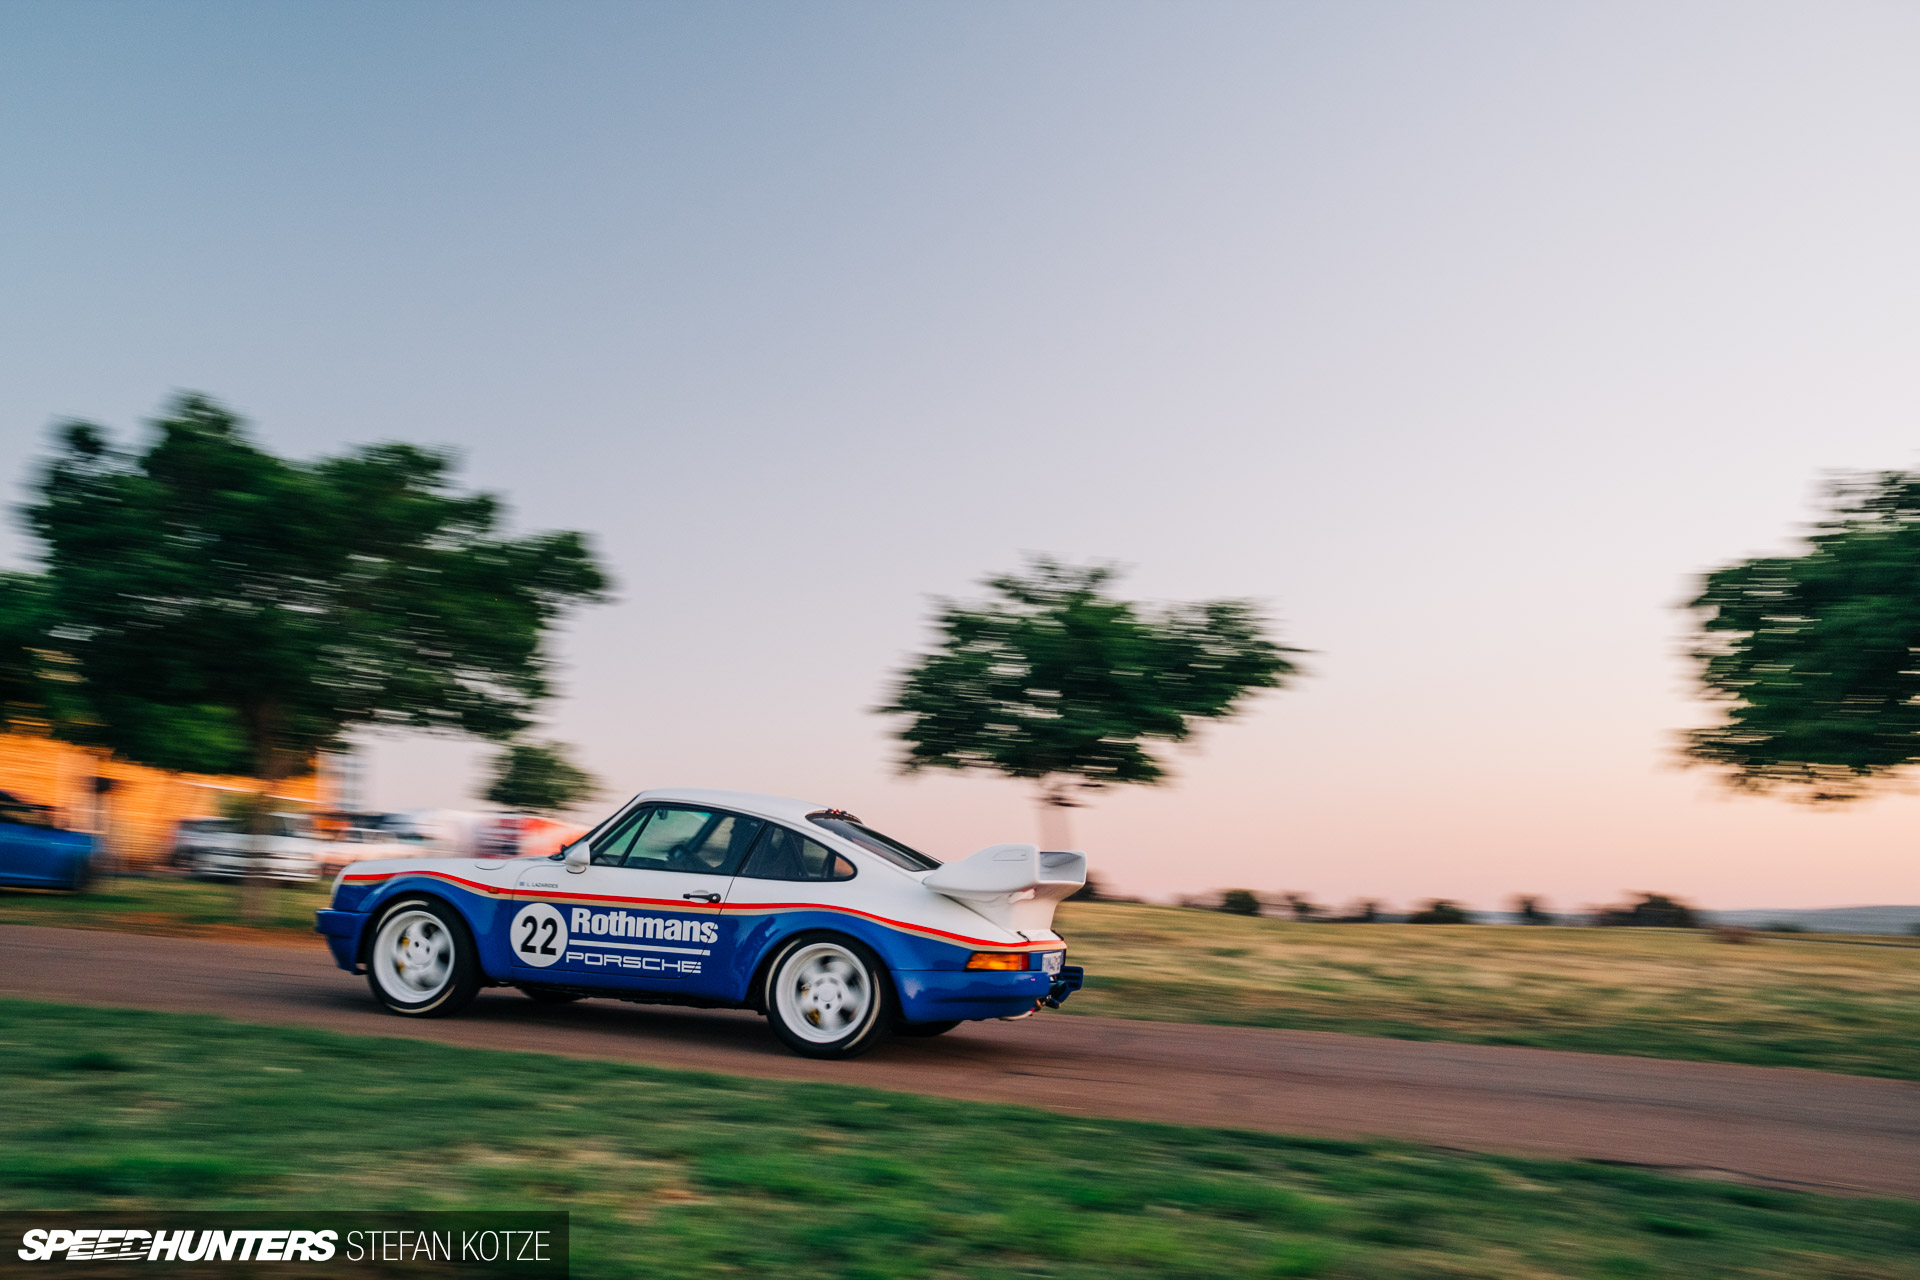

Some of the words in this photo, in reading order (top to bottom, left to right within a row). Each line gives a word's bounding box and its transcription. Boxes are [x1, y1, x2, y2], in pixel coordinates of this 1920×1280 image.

[520, 915, 558, 956] 22
[571, 908, 718, 944] Rothmans
[566, 951, 702, 973] PORSCHE
